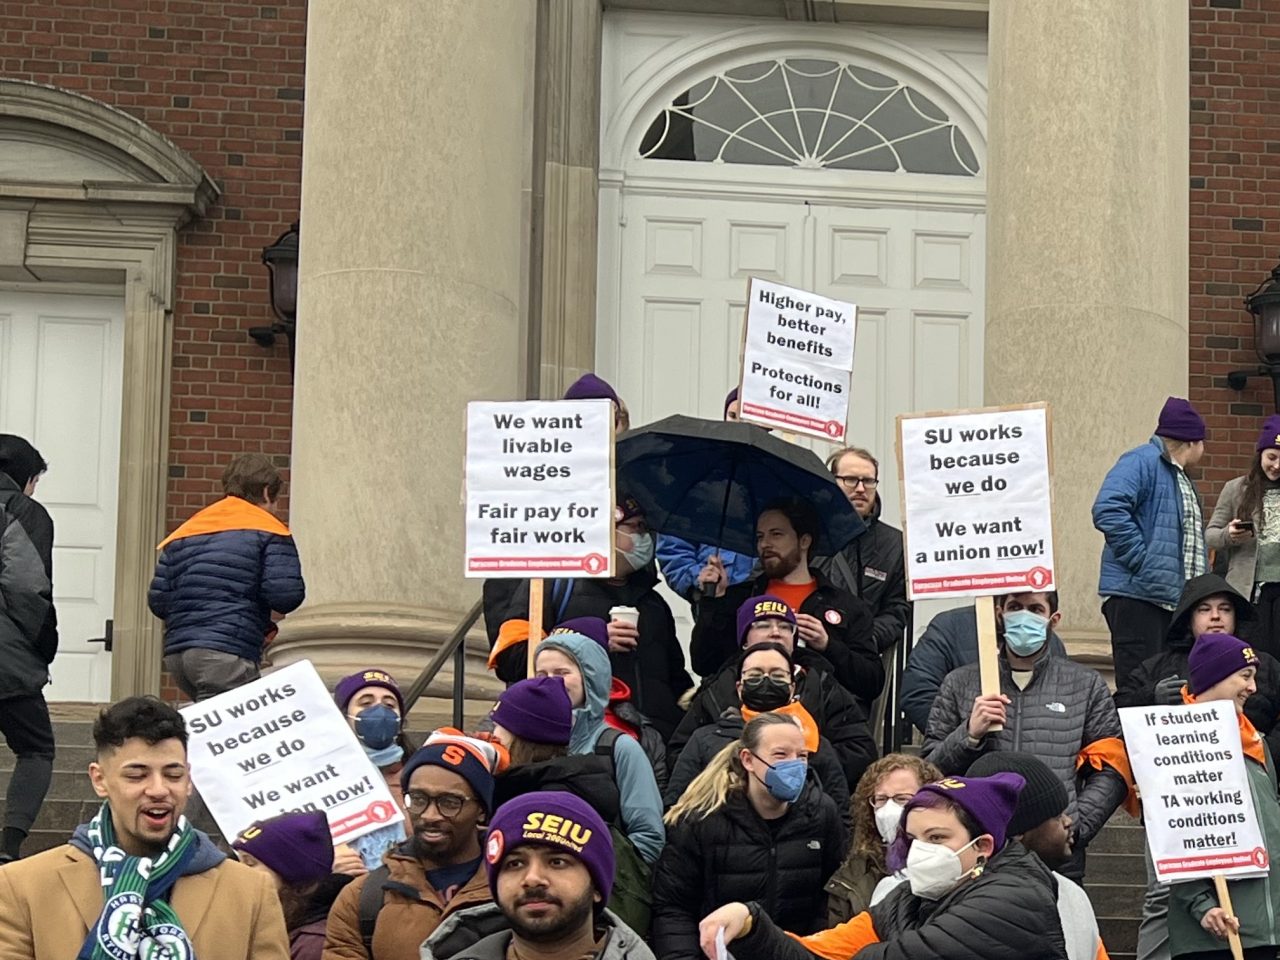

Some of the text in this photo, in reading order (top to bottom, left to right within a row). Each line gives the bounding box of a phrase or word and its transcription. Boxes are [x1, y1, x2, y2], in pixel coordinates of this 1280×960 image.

[759, 290, 847, 324] Higher pay,
[778, 314, 827, 336] better
[767, 331, 833, 357] benefits
[751, 362, 843, 394] Protections
[769, 385, 821, 409] for all!
[493, 413, 583, 429] We want
[924, 424, 1023, 445] SU works
[502, 438, 573, 454] livable
[929, 451, 1020, 470] because
[503, 464, 571, 481] wages
[945, 476, 1007, 495] we do
[478, 503, 598, 522] Fair pay for
[490, 528, 586, 544] fair work
[936, 516, 1022, 538] We want
[915, 539, 1045, 564] a union now!
[754, 601, 787, 614] SEIU
[189, 683, 297, 734] SU works
[1145, 708, 1219, 727] If student
[207, 709, 307, 757] because
[1156, 730, 1220, 746] learning
[237, 738, 306, 773] we do
[441, 745, 466, 766] S
[1153, 750, 1233, 767] conditions
[242, 788, 281, 811] We
[284, 763, 340, 795] want
[1174, 770, 1223, 785] matter
[321, 775, 374, 807] now!
[1161, 790, 1243, 809] TA working
[522, 812, 592, 845] SEIU
[1168, 812, 1246, 829] conditions
[1183, 831, 1237, 849] matter!
